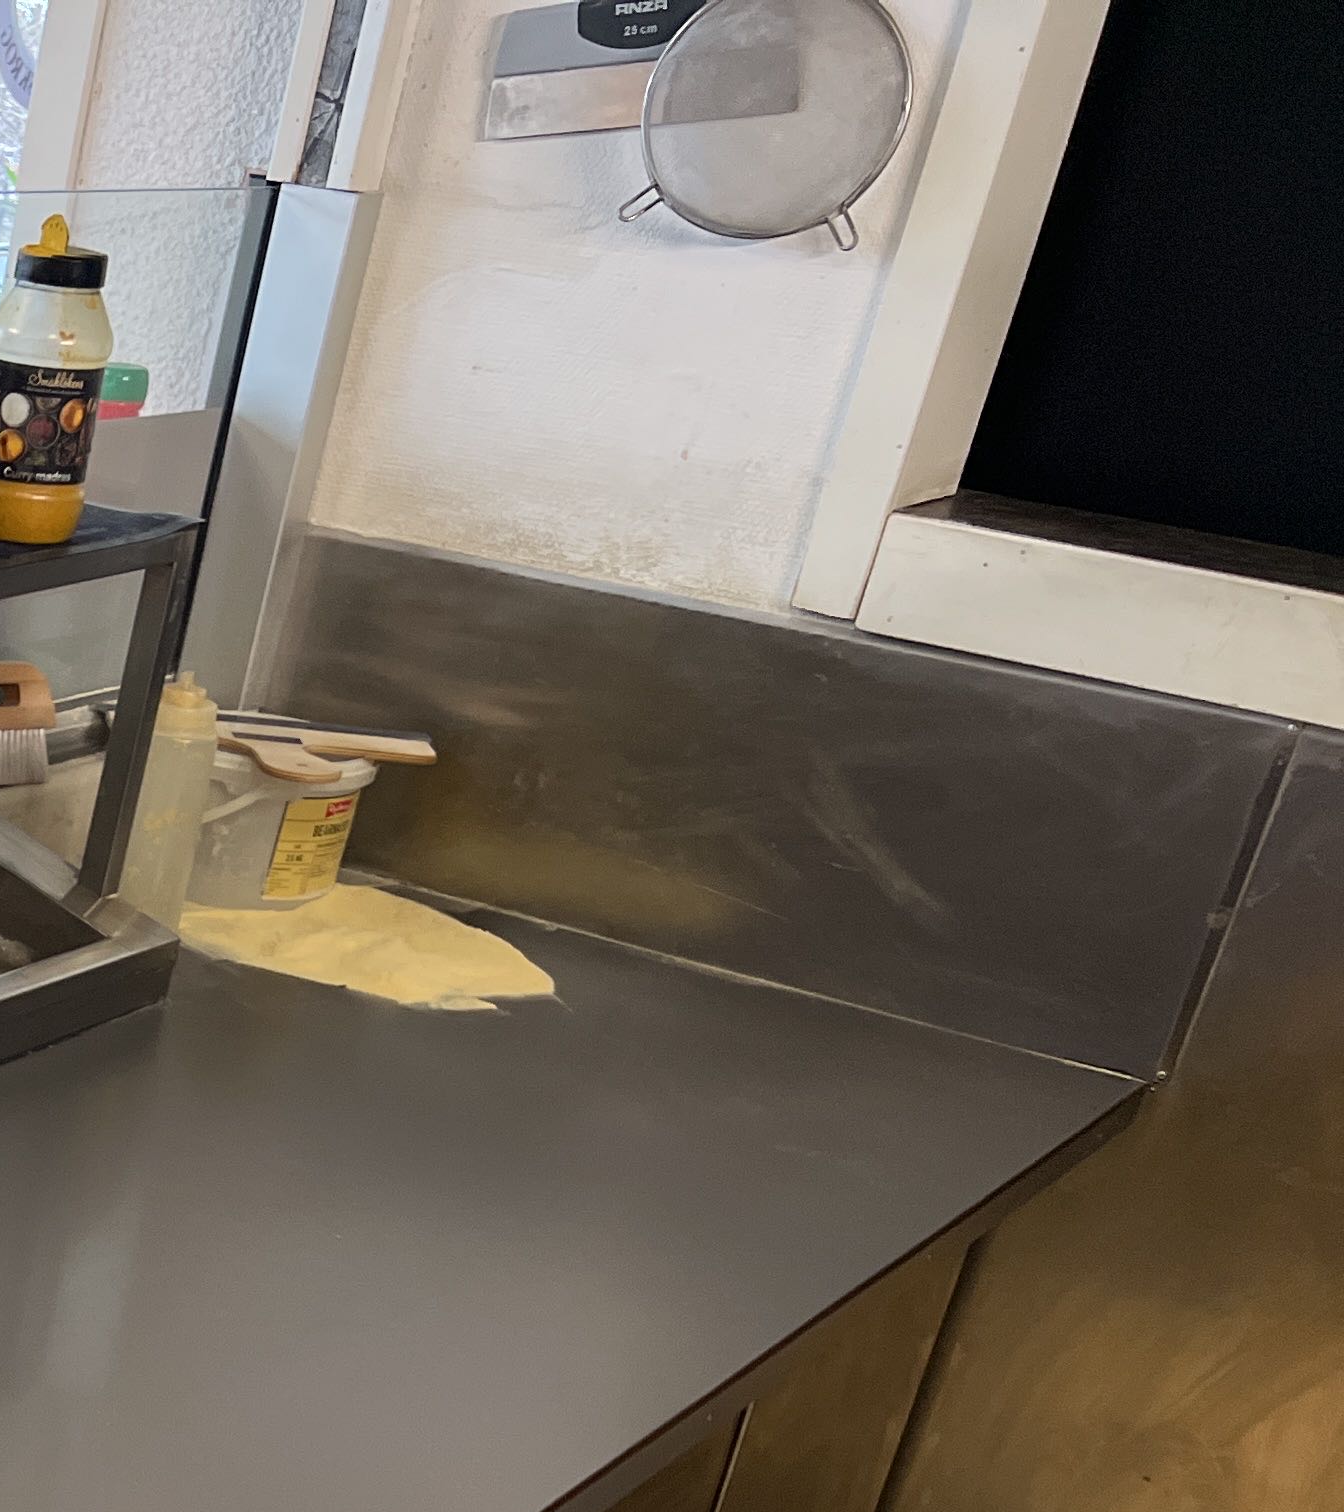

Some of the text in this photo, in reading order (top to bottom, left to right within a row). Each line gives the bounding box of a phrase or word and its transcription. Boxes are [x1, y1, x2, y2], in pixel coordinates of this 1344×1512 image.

[615, 0, 668, 16] ANZA
[624, 25, 659, 37] 25 cm
[3, 466, 34, 483] Curry
